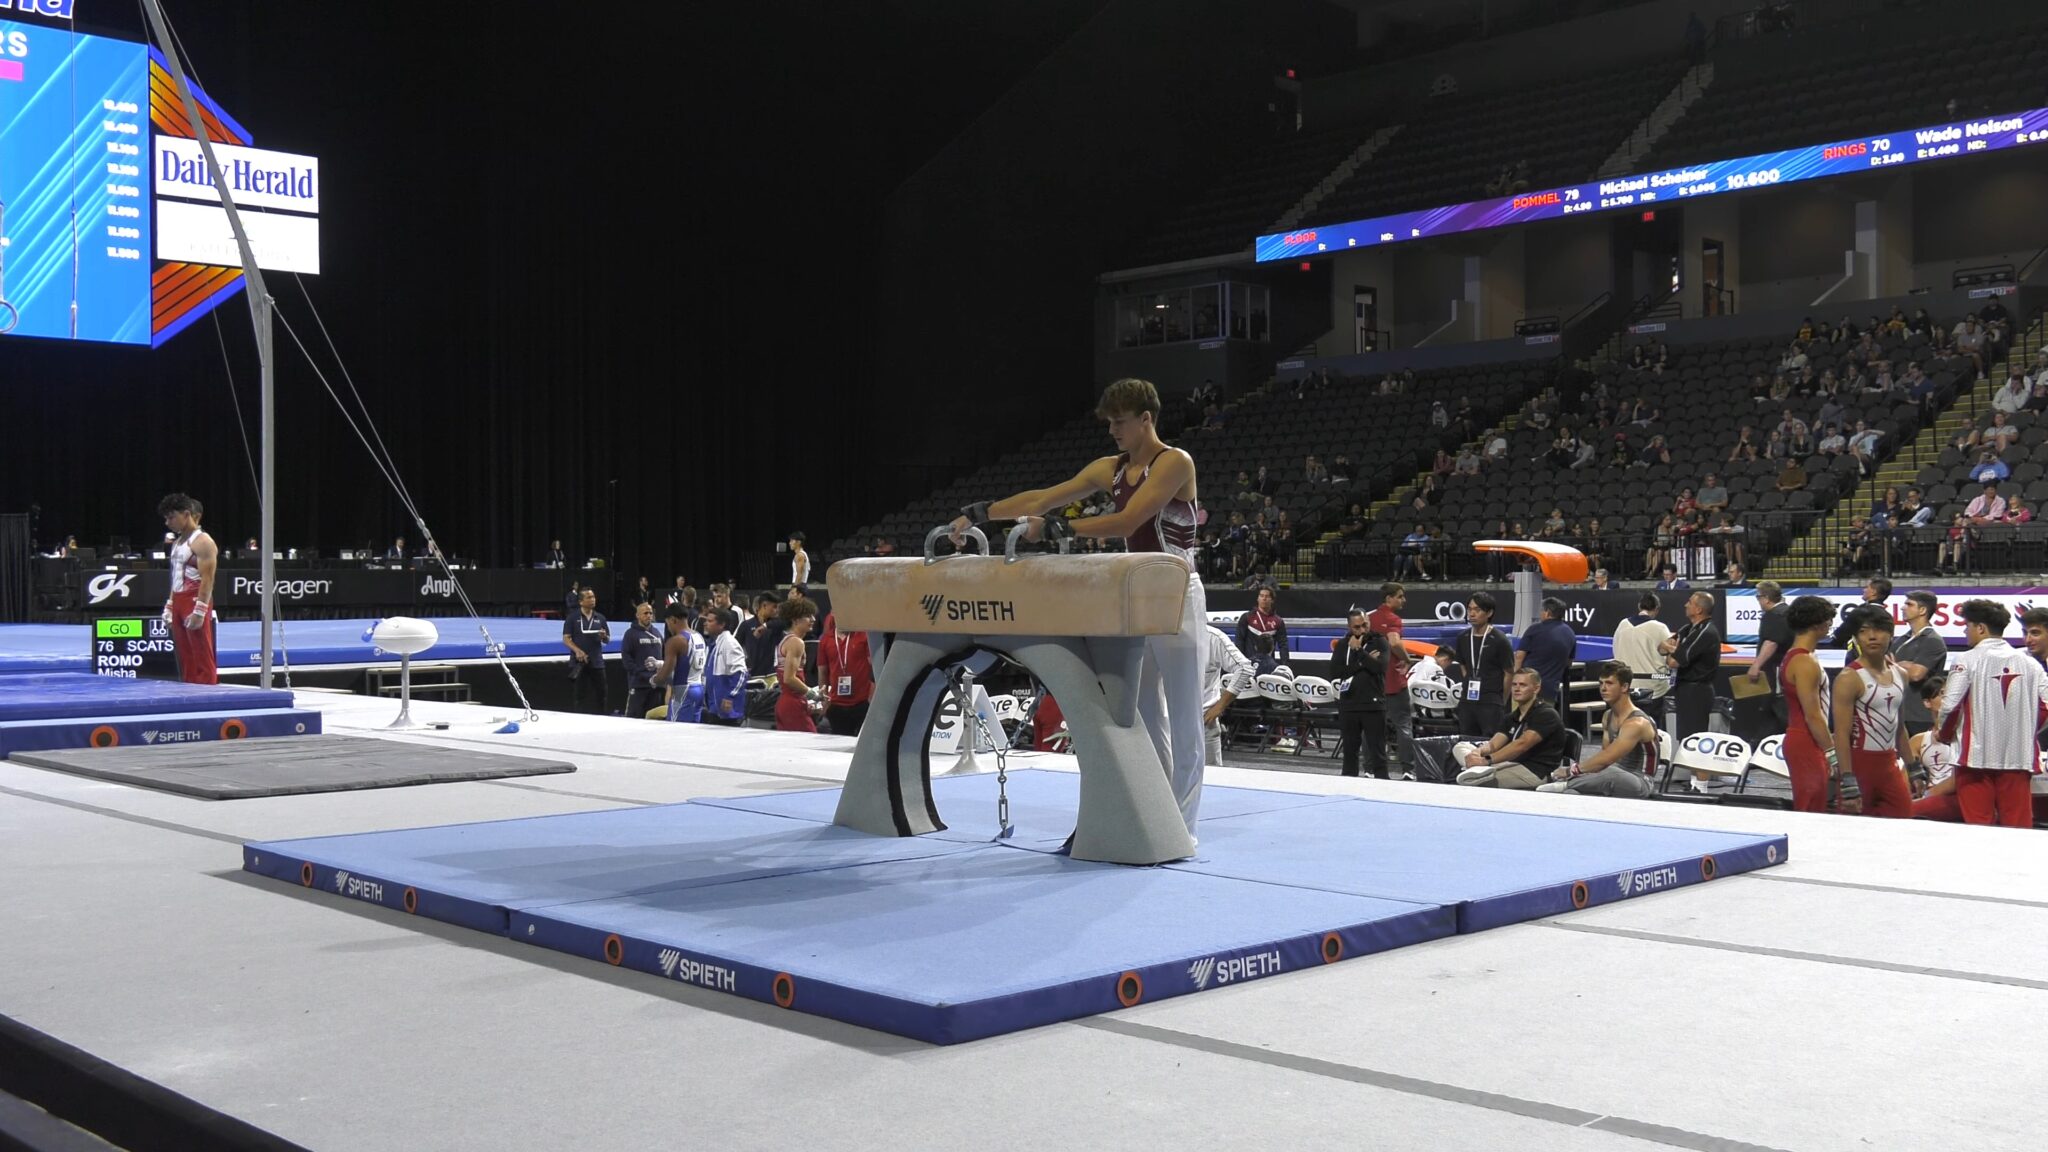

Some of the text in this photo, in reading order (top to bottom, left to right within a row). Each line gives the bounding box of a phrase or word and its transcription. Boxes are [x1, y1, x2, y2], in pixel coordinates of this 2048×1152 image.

[1823, 118, 2023, 159] RINGS 70 Wade Nelson
[233, 158, 313, 198] Herald
[1513, 169, 1780, 209] POMMEL 79 Michael Scheiner 10.600
[421, 575, 455, 597] Angi
[946, 600, 1015, 621] SPIETH
[110, 623, 130, 635] GO
[97, 640, 175, 652] 76 SCATS
[97, 655, 143, 667] ROMO
[98, 668, 137, 679] Misha
[1258, 681, 1291, 694] core
[1294, 682, 1328, 696] core
[1411, 687, 1448, 701] core
[159, 730, 200, 742] SPIETH
[1682, 736, 1744, 758] core
[348, 877, 383, 902] SPIETH
[1634, 866, 1677, 892] SPIETH
[680, 958, 736, 992] SPIETH
[1216, 950, 1280, 983] SPIETH
